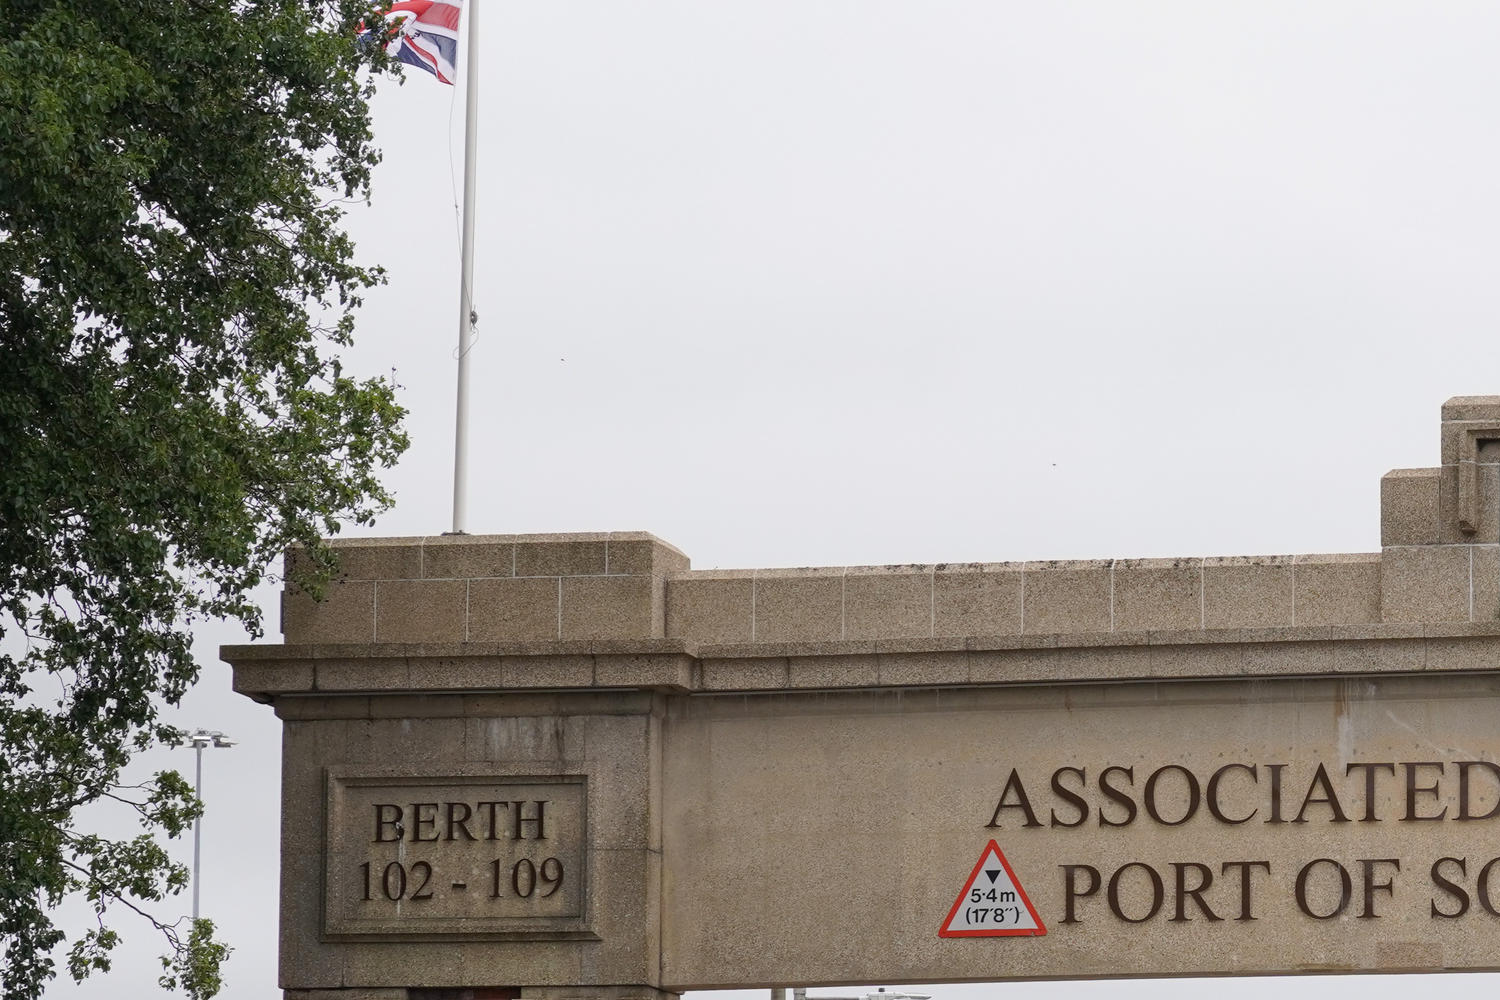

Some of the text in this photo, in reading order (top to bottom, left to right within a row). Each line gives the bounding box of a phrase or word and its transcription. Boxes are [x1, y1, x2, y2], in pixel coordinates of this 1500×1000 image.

[372, 800, 549, 843] BERTH
[359, 860, 434, 901] 102
[489, 857, 565, 899] 109
[1058, 860, 1270, 925] PORT
[1295, 858, 1400, 920] OF
